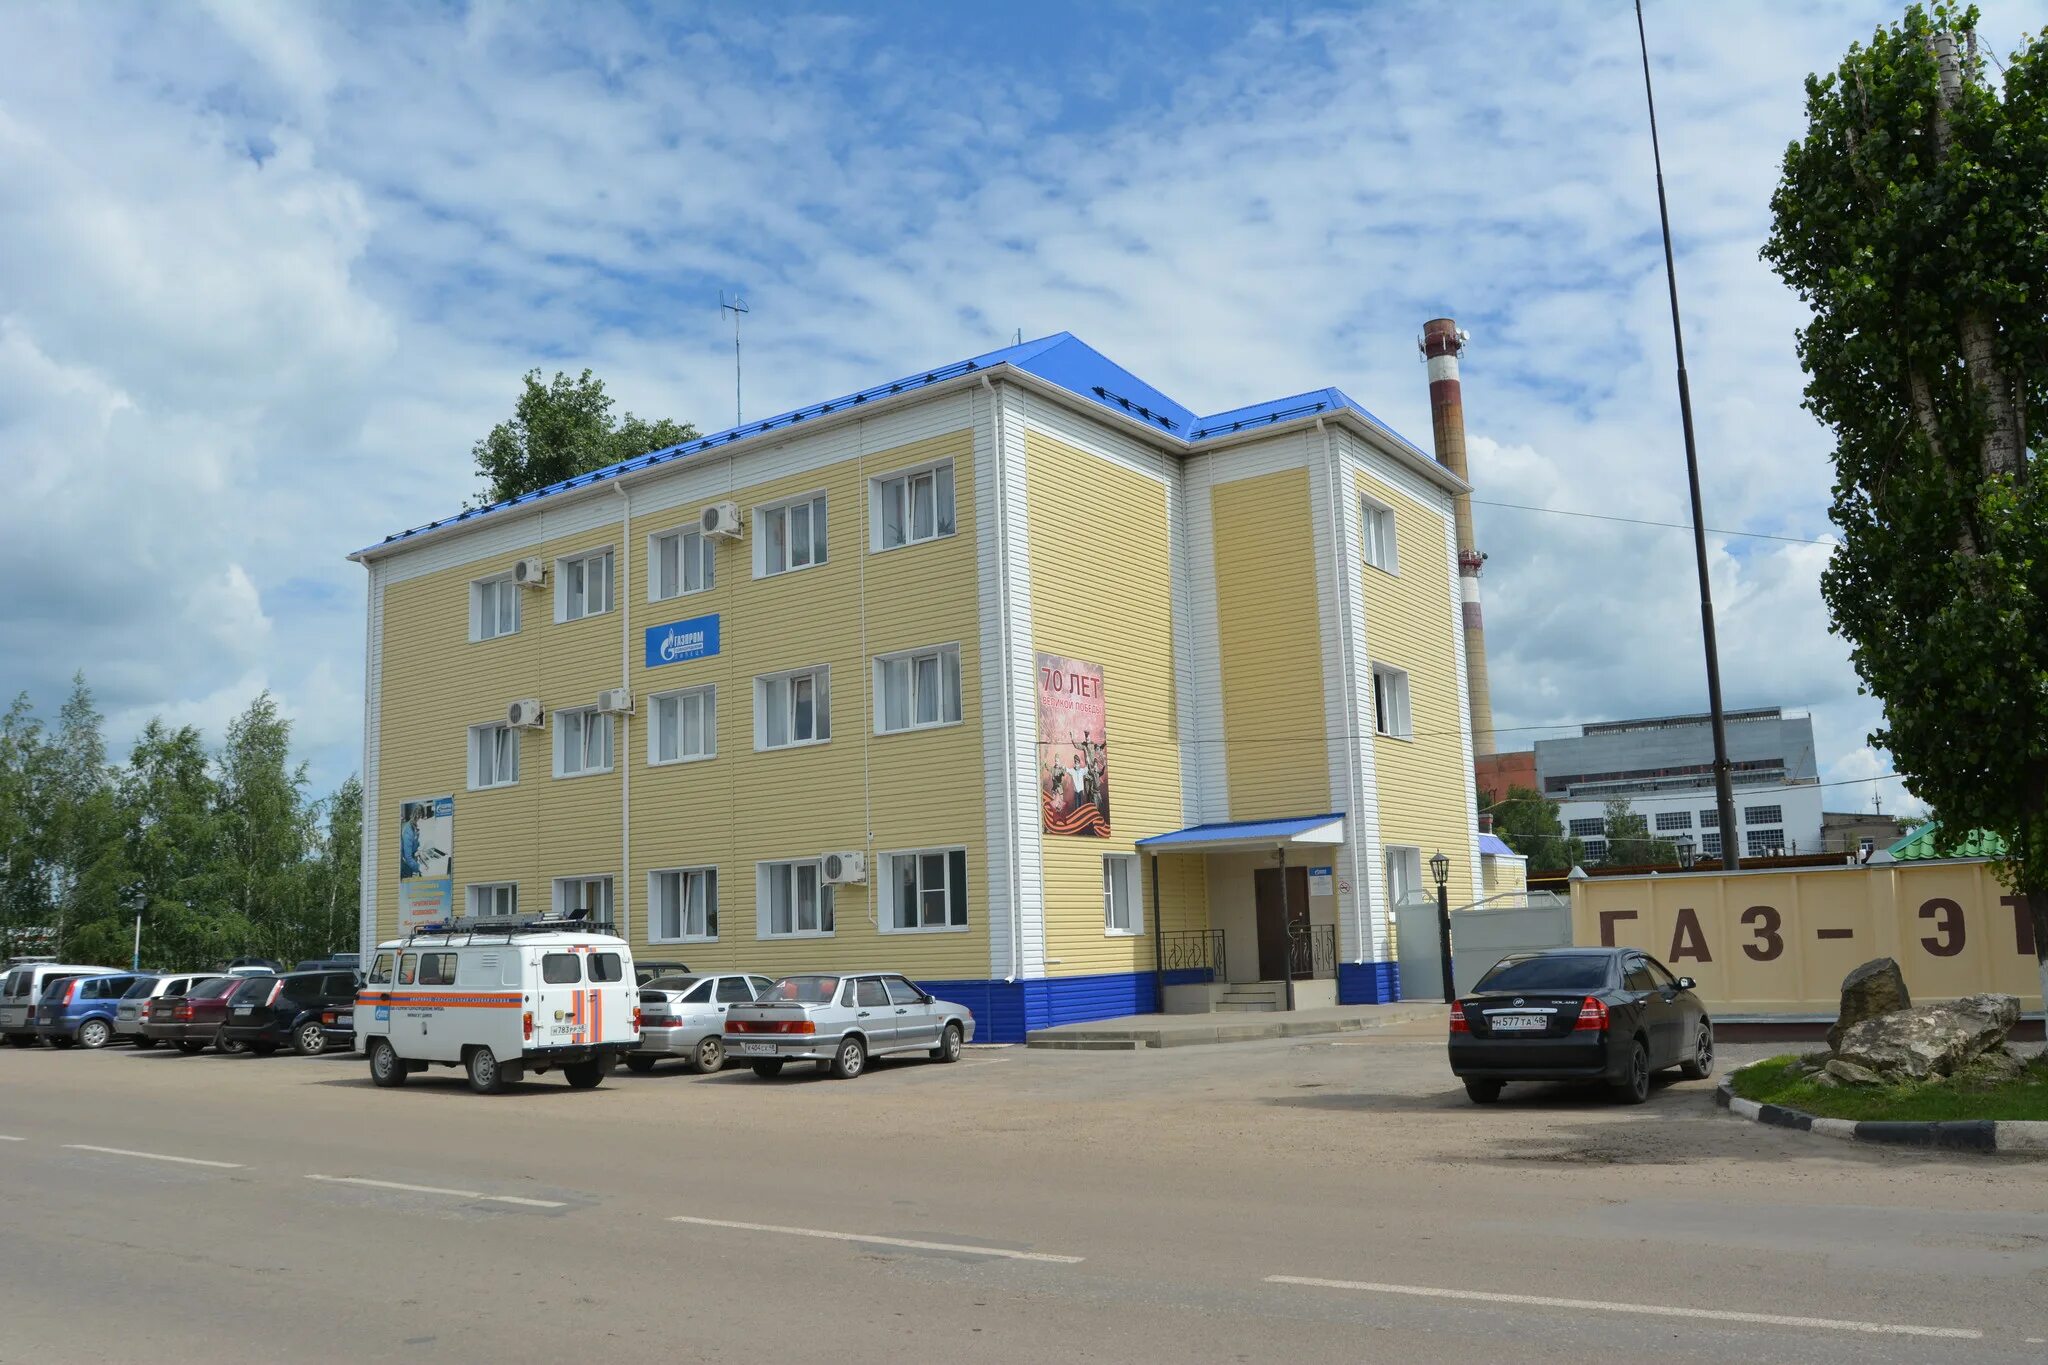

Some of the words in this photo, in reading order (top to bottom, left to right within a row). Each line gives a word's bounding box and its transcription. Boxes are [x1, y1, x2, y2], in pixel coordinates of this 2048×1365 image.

[1042, 668, 1063, 692] 70
[1069, 674, 1100, 698] ЛЕТ
[1043, 697, 1073, 709] ВЕЛИКОЙ
[1076, 702, 1102, 715] ПОБЕДЫ
[1600, 905, 1785, 963] ГАЗ
